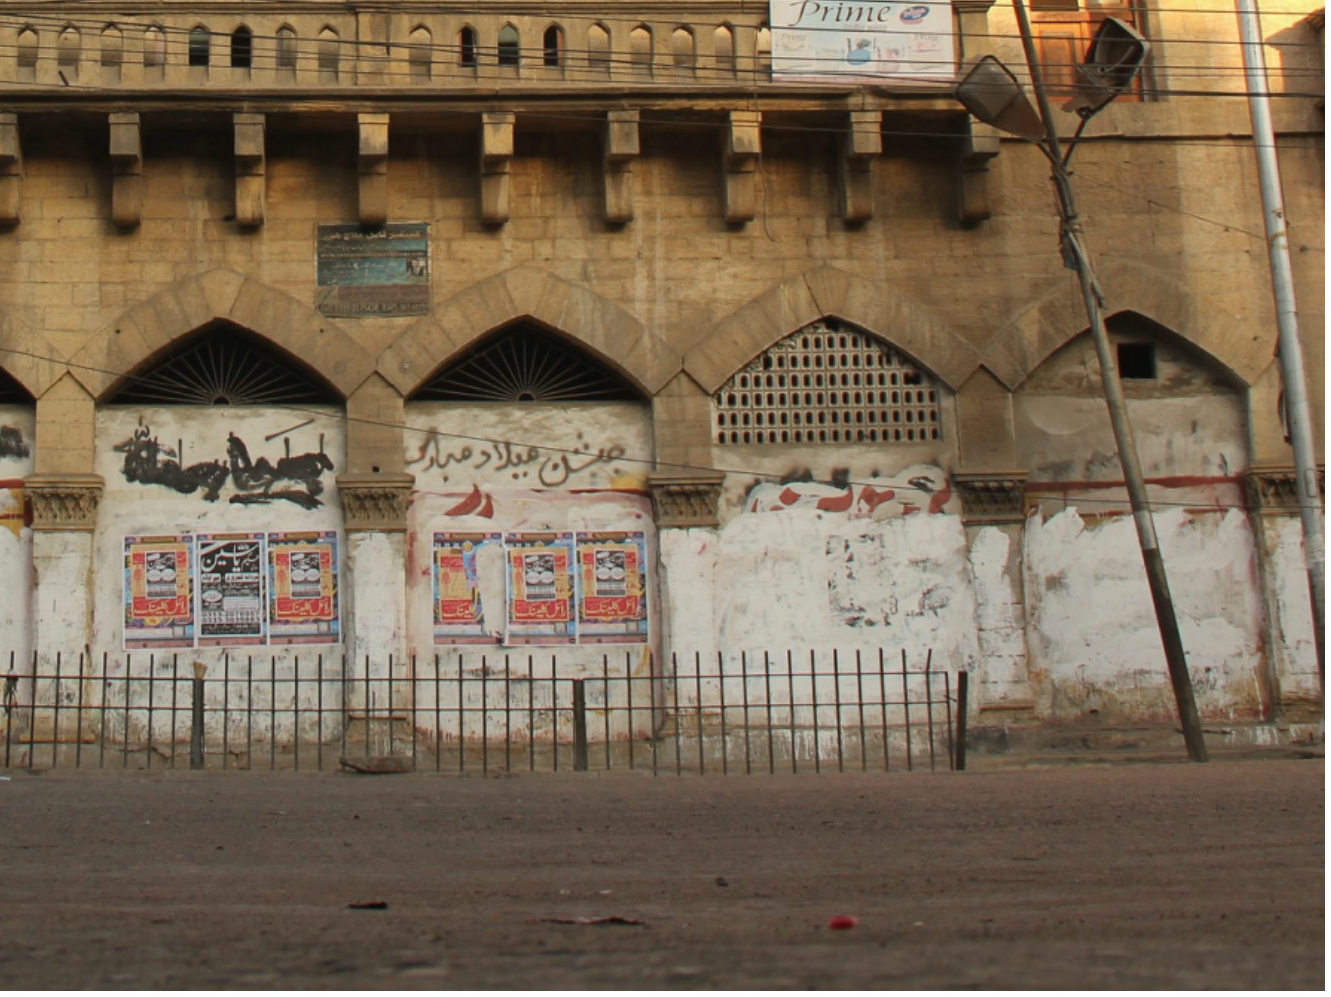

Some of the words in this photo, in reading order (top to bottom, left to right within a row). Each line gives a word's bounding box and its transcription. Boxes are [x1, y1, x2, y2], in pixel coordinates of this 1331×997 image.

[787, 0, 892, 26] Prime
[474, 441, 540, 480] میلاد
[538, 432, 625, 487] جشن
